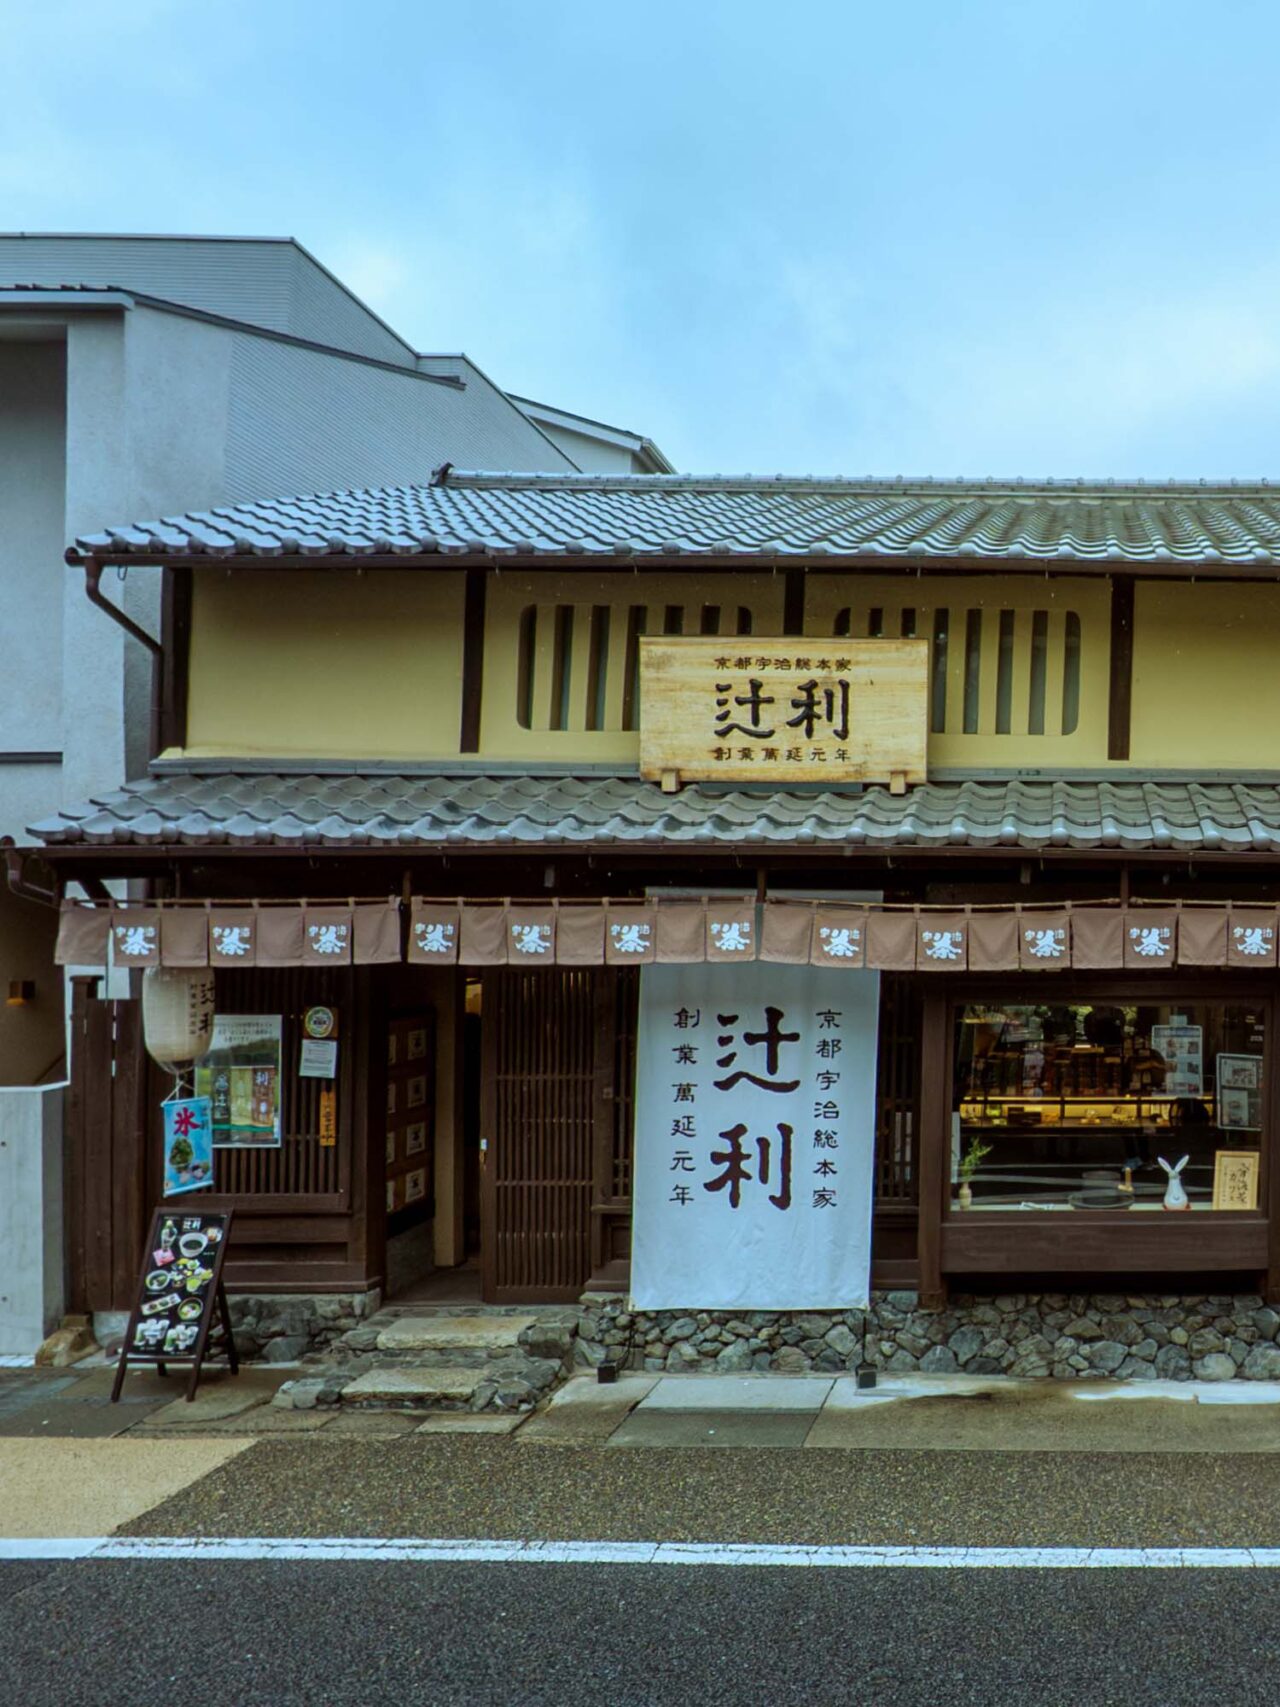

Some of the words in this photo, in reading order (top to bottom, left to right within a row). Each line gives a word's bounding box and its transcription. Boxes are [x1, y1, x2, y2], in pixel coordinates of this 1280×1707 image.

[714, 656, 853, 672] 京都宇治総本家
[714, 678, 851, 740] 辻利
[712, 747, 852, 762] 創業萬延元年
[174, 1107, 200, 1136] 氷
[669, 1007, 701, 1206] 創業萬延元年
[703, 1006, 801, 1210] 辻利
[812, 1010, 844, 1209] 京都宇治総本家
